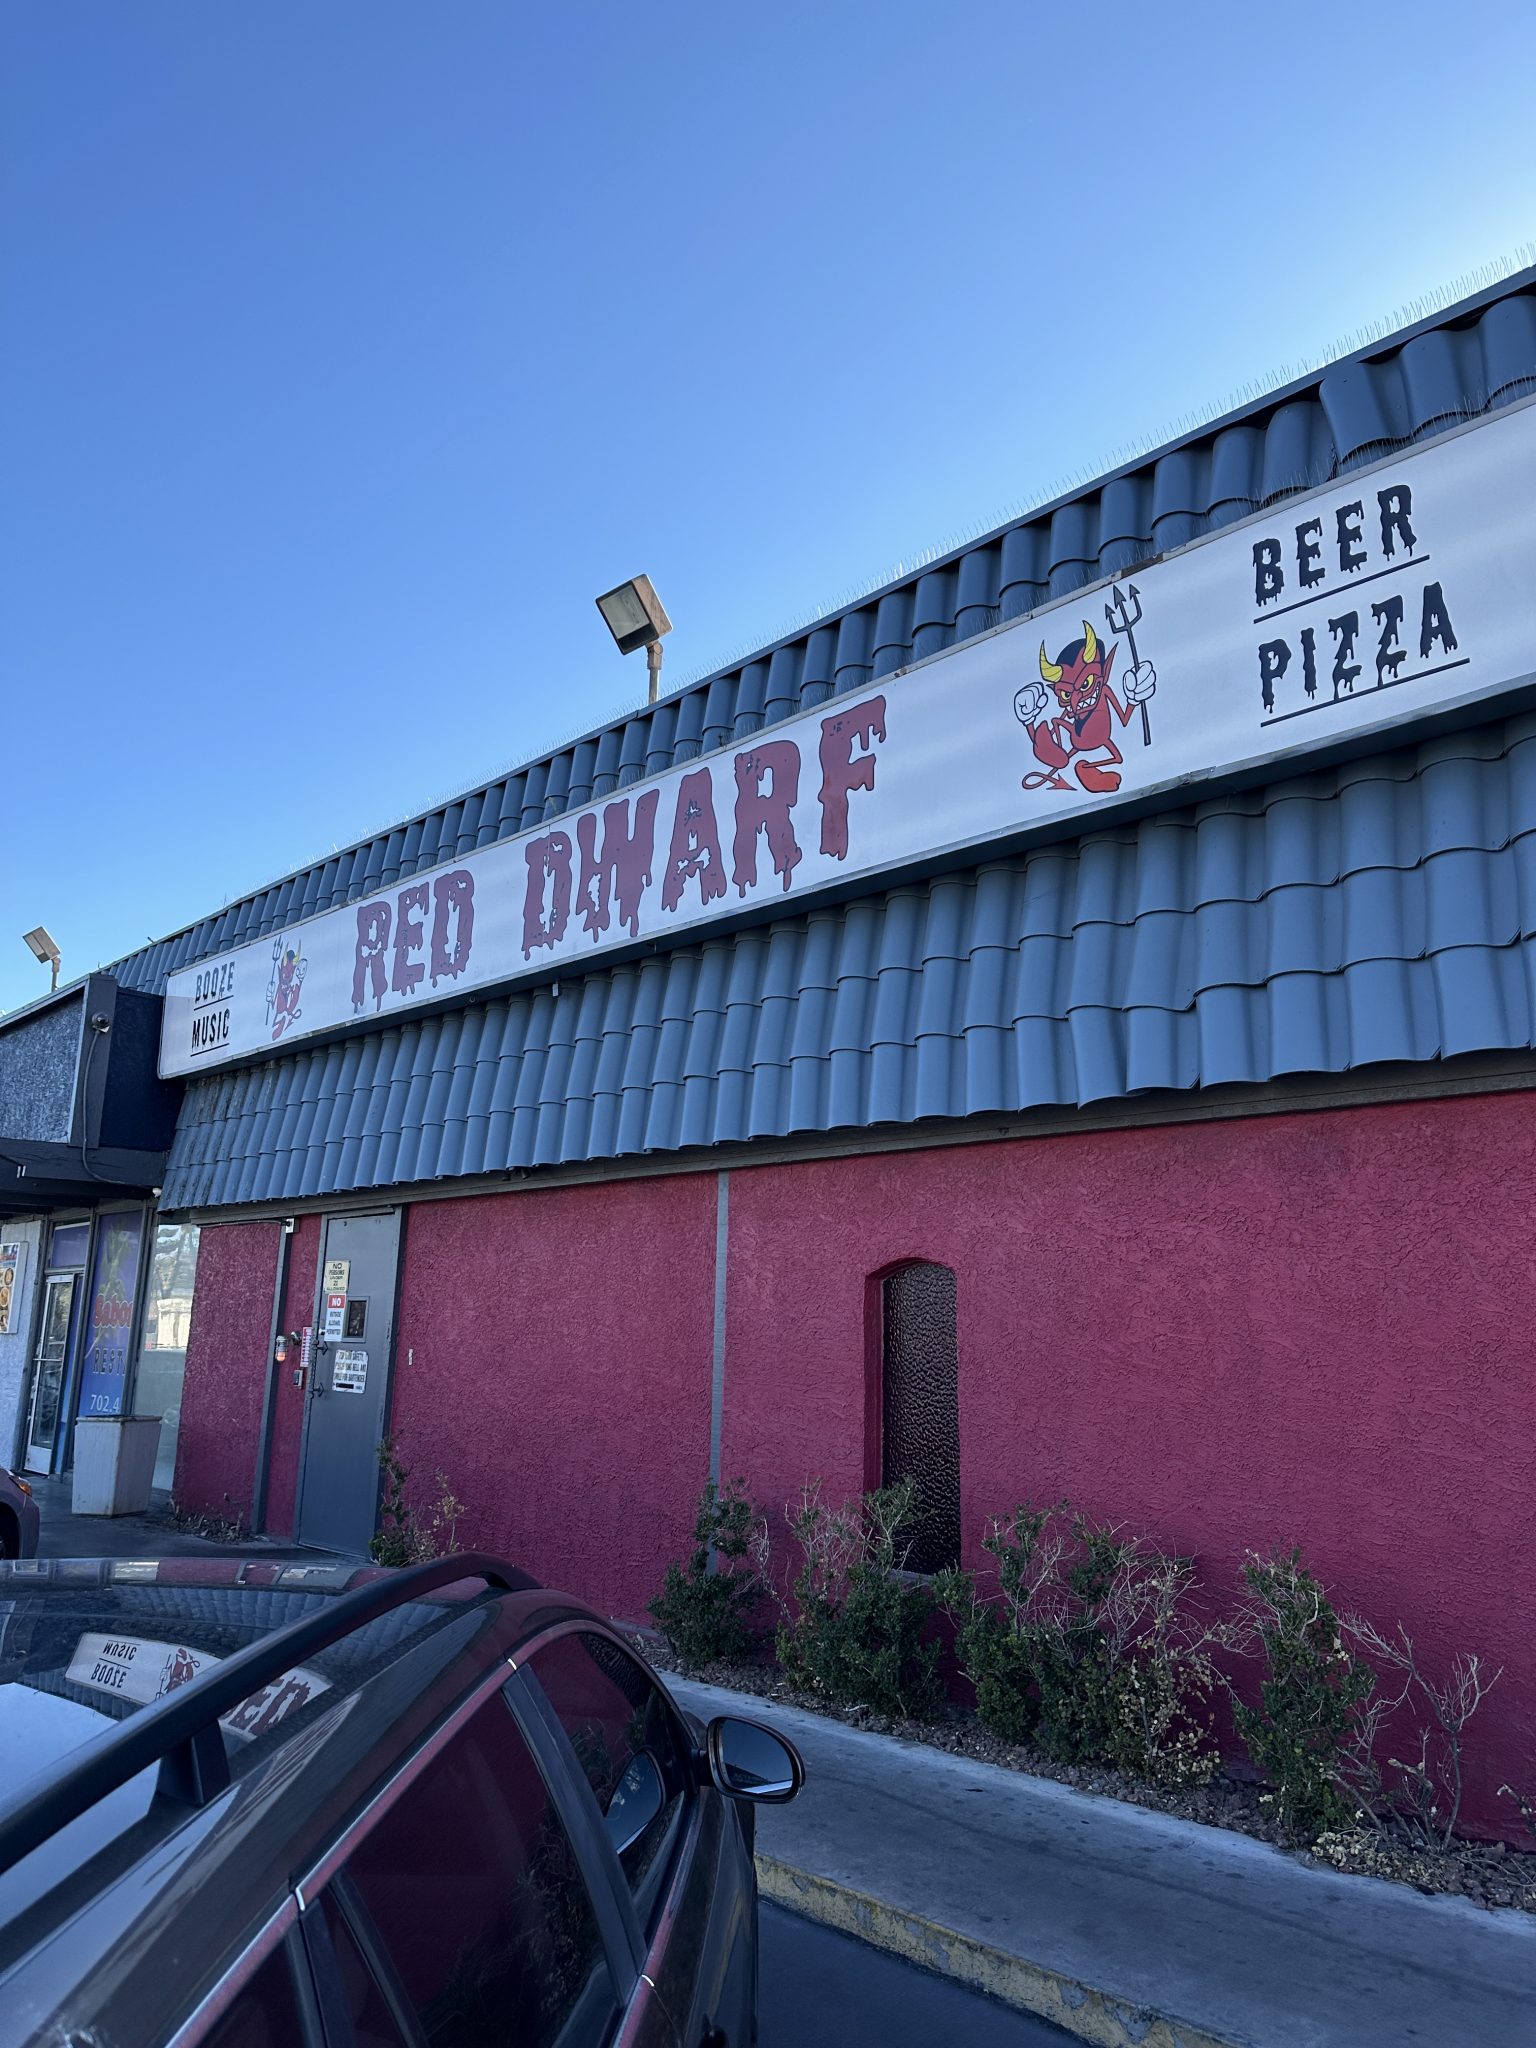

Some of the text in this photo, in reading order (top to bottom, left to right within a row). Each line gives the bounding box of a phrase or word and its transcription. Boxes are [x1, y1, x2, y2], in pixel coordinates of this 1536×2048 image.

[1252, 484, 1418, 608] BEER
[1258, 581, 1459, 714] PIZZA
[351, 695, 887, 1013] RED DWARF
[194, 961, 235, 1004] BOOZE
[191, 1007, 231, 1052] MUSIC
[332, 1298, 342, 1307] NO
[90, 1394, 120, 1414] 702.4
